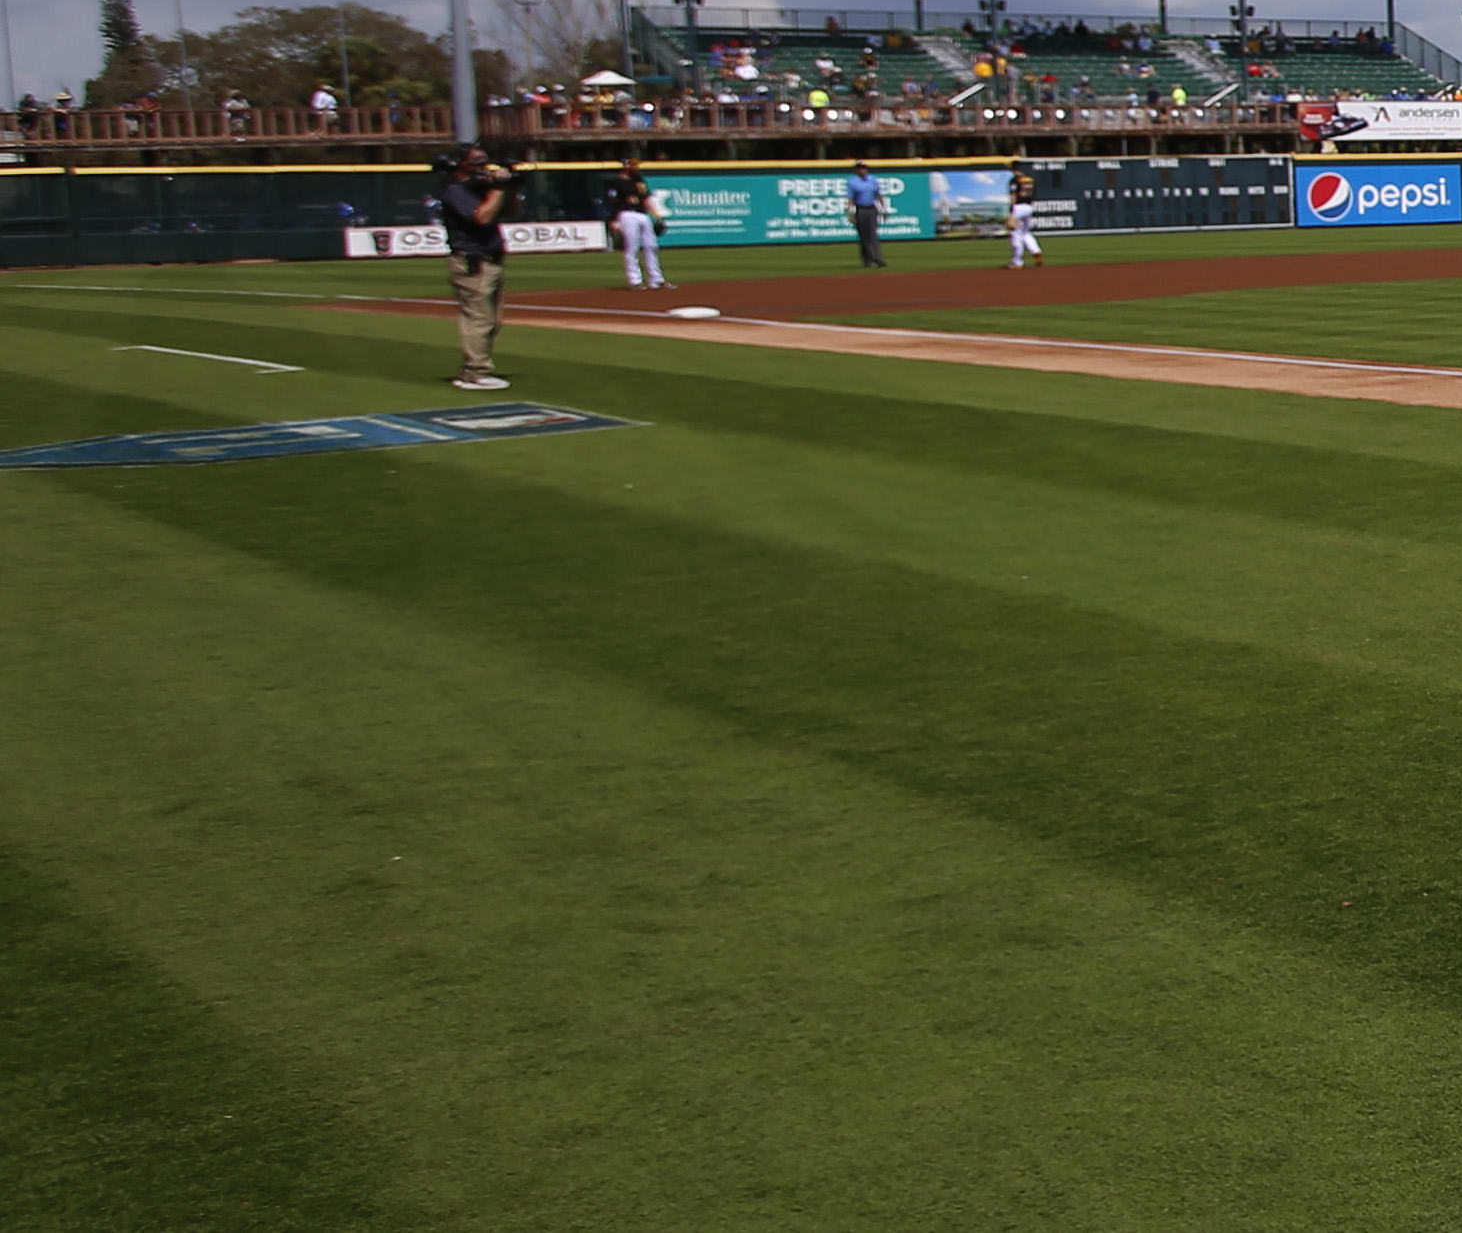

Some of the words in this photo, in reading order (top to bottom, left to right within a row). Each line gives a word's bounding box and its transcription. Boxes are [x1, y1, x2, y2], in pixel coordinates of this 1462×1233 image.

[1398, 106, 1460, 119] andersen
[778, 177, 905, 197] PREFEED
[1358, 178, 1447, 214] pepsi
[671, 188, 751, 205] Manatee
